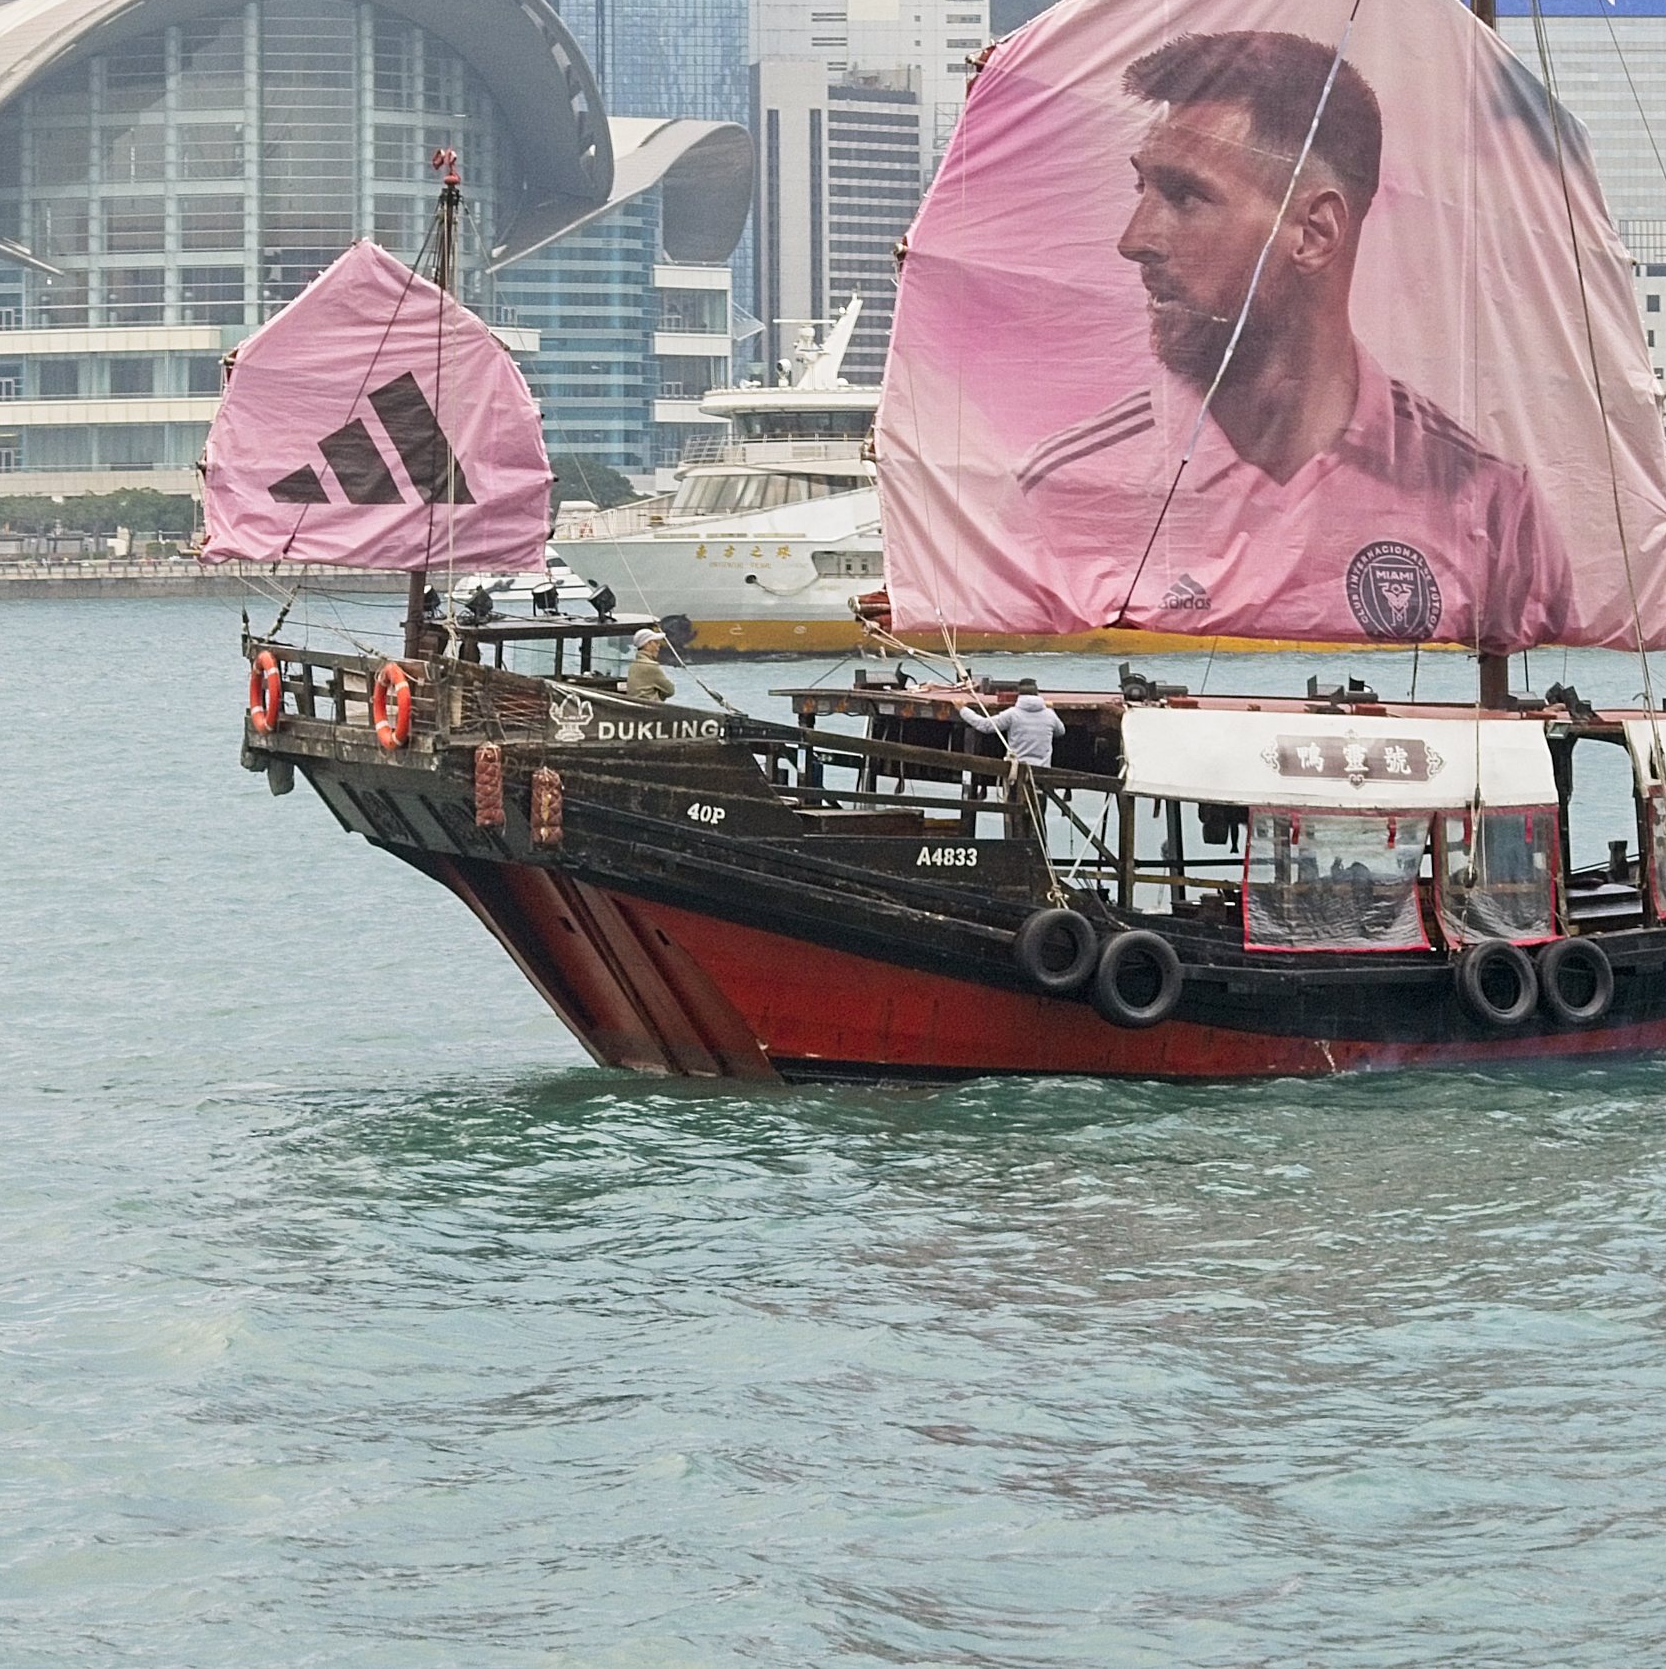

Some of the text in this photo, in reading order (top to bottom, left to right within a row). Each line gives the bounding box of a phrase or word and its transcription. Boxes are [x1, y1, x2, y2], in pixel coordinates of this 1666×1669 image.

[1350, 544, 1424, 589] INTERNACIONAL
[1375, 570, 1414, 582] MIAMI
[1351, 593, 1369, 625] CLUB
[598, 719, 719, 740] DUKLING
[1296, 742, 1412, 775] 鴨靈號
[686, 802, 726, 825] 40P
[916, 846, 978, 867] A4833
